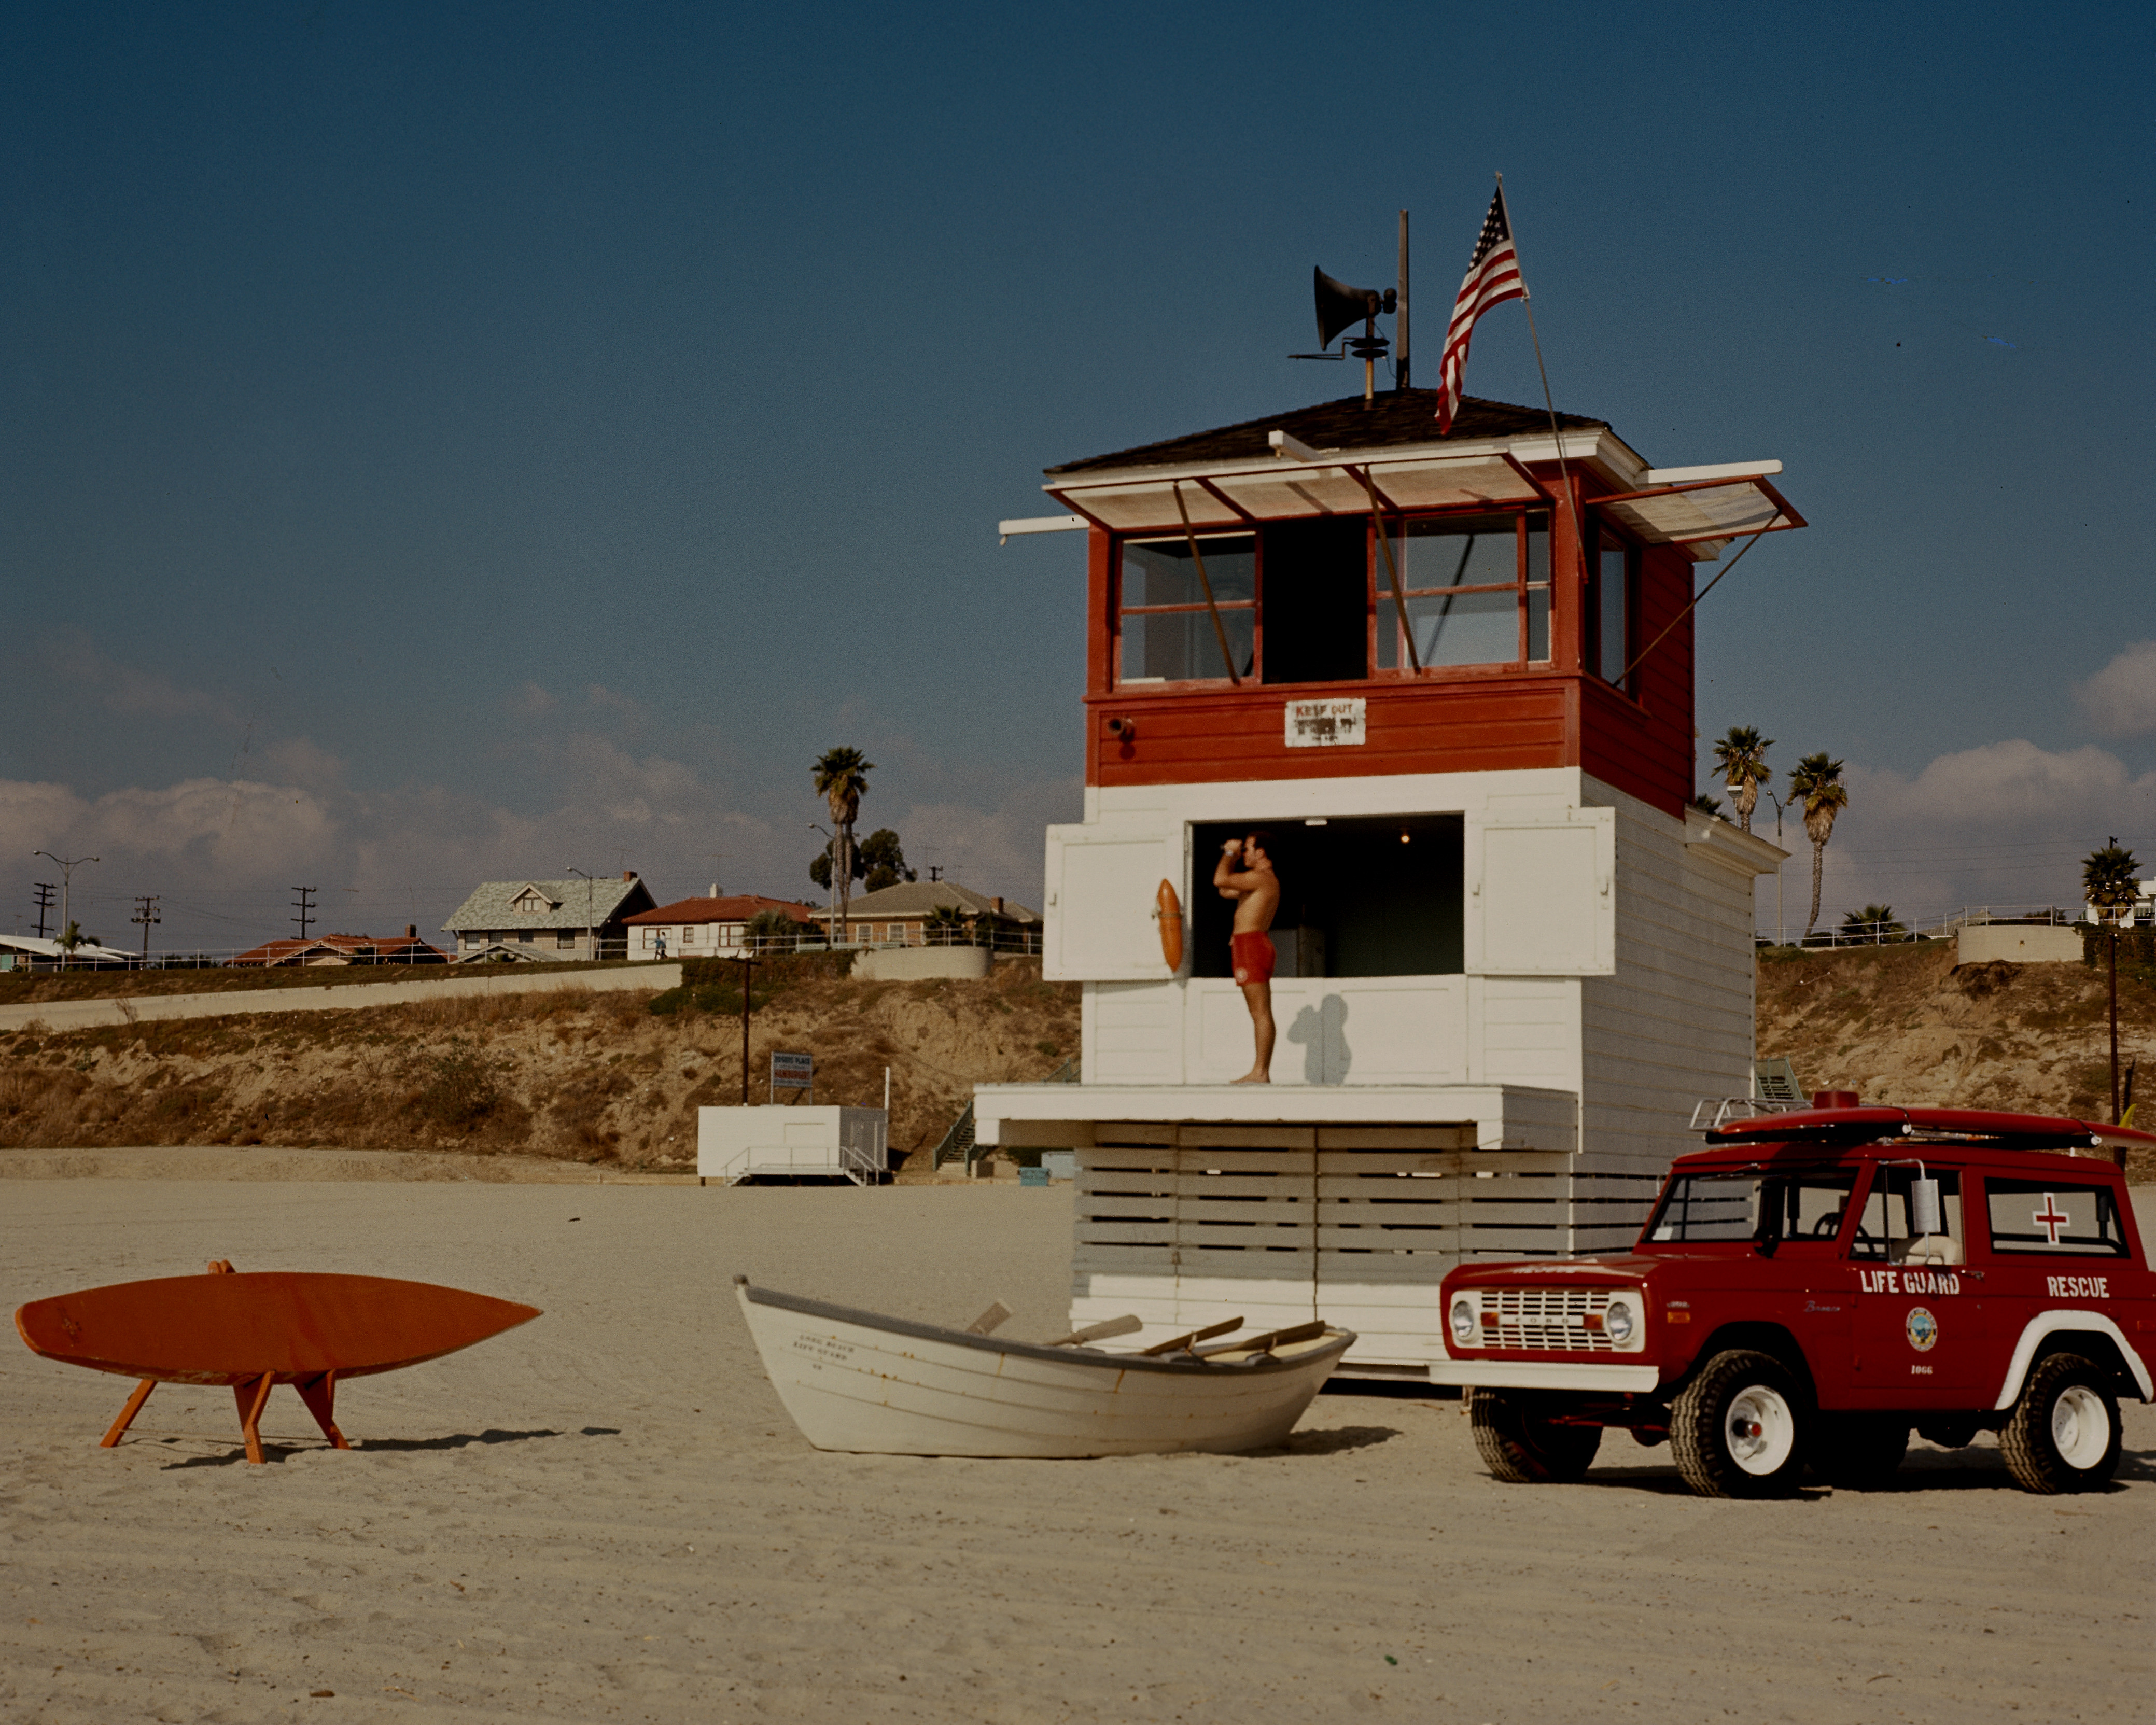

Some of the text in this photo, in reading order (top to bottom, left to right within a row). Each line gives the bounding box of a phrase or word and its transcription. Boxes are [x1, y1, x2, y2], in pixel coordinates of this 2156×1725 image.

[1331, 704, 1352, 715] OUT
[1860, 1270, 1960, 1295] LIFE GUARD
[2046, 1276, 2110, 1298] RESCUE
[1911, 1364, 1934, 1375] 1066
